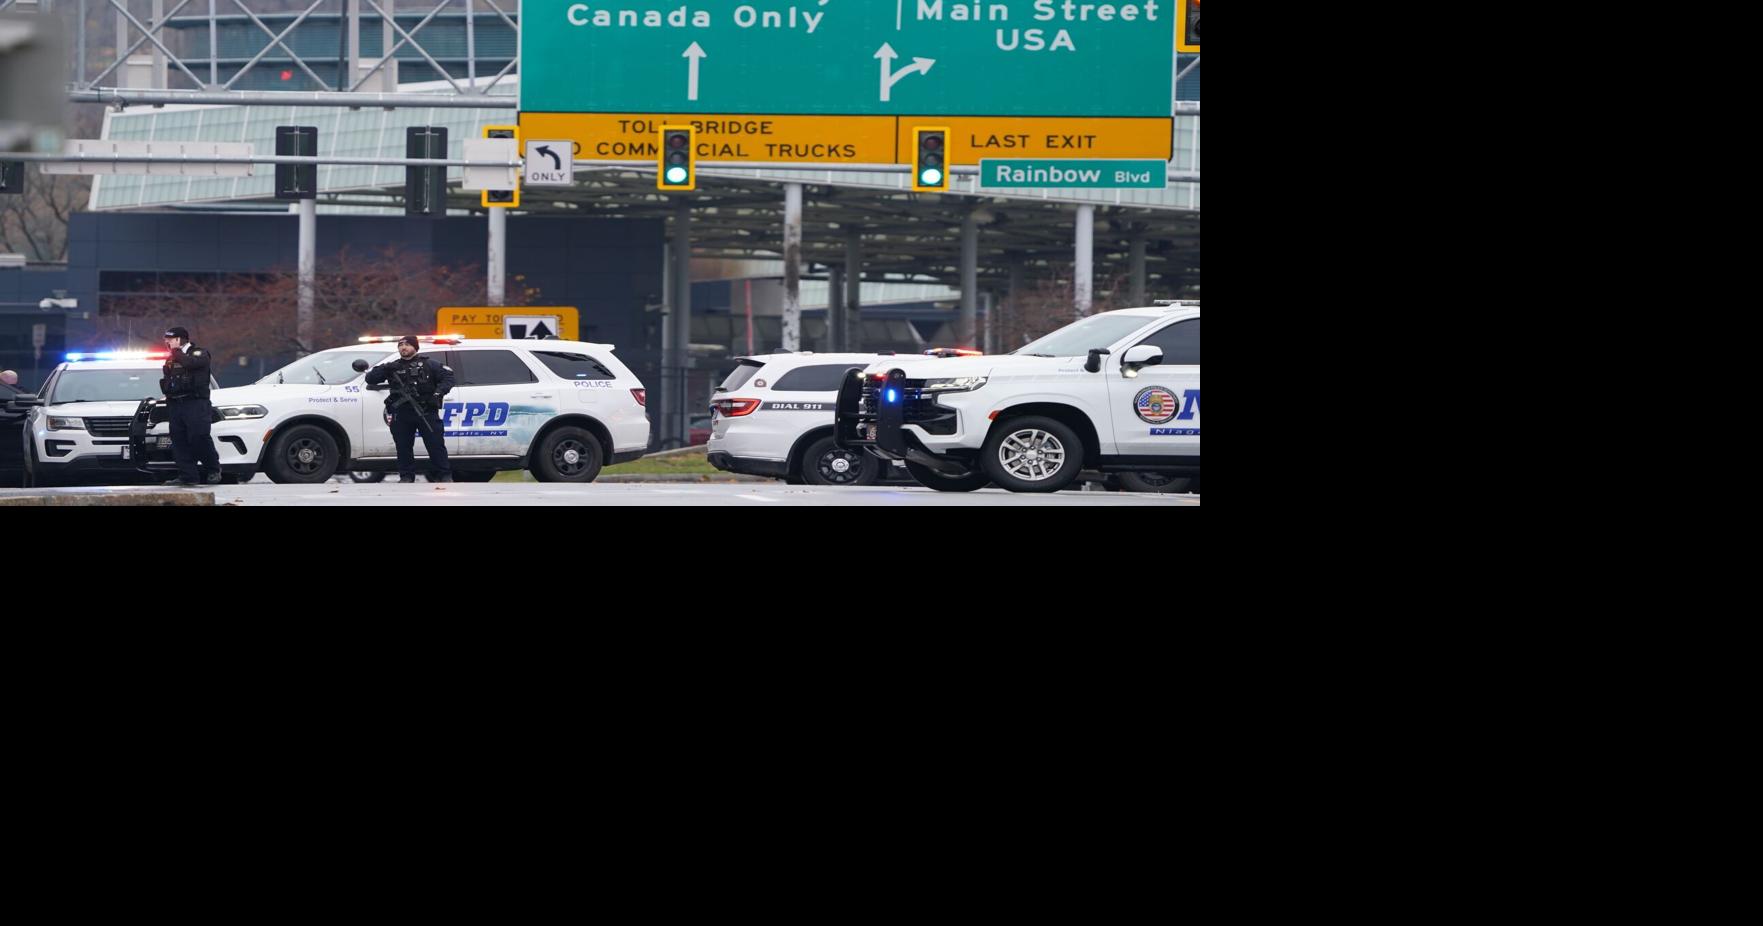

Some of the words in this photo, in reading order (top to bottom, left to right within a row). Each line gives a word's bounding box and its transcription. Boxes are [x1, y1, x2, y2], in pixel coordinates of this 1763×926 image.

[917, 0, 1008, 20] Main
[1033, 0, 1159, 21] Street
[567, 4, 711, 27] Canada
[734, 5, 824, 33] Only
[996, 29, 1076, 51] USA
[619, 120, 667, 134] TOL
[690, 121, 773, 135] BRIDGE
[971, 135, 1030, 148] LAST
[1046, 135, 1097, 149] EXIT
[596, 143, 749, 157] COMMCIAL
[765, 143, 856, 158] TRUCKS
[531, 172, 565, 182] ONLY
[996, 165, 1101, 183] Rainbow
[1114, 171, 1150, 183] Blvd
[452, 314, 477, 323] PAY
[574, 380, 612, 388] POLICE
[442, 402, 510, 427] FPD
